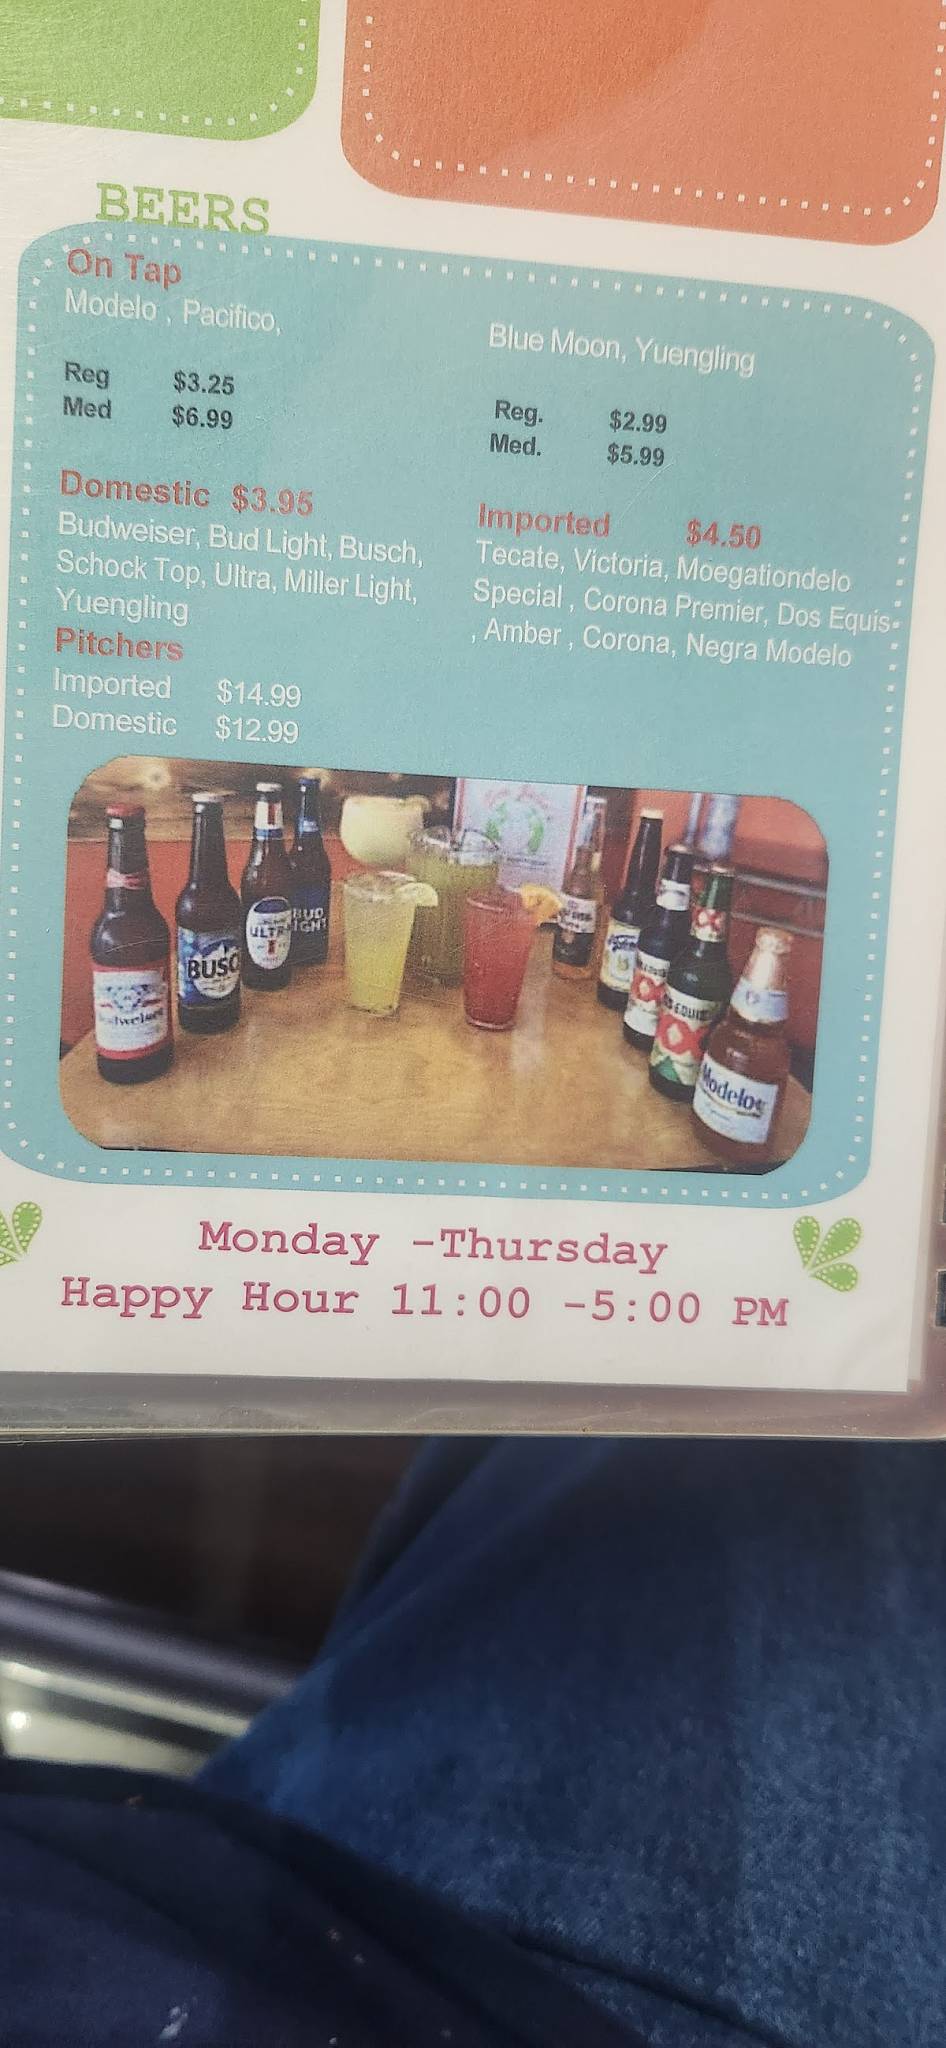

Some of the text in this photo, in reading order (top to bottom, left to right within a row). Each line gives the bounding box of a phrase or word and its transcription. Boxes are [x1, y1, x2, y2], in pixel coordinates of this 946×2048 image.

[96, 182, 271, 236] BEERS
[67, 248, 183, 291] On Tap
[64, 287, 157, 321] Modelo
[183, 299, 282, 336] Pacifico,
[489, 323, 756, 379] Blue Moon, Yuengling
[64, 361, 235, 397] Reg $3.25
[62, 396, 234, 431] Med $6.99
[494, 399, 668, 435] Reg. $2.99
[489, 433, 665, 468] Med. $5.99
[60, 468, 314, 518] Domestic $3.95
[58, 511, 424, 569] Budweiser, Bud Light, Busch,
[478, 502, 762, 551] Imported $4.50
[56, 549, 418, 606] Schock Top, Ultra, Miller Light,
[475, 539, 852, 594] Tecate, Victoria, Moegationdelo
[56, 587, 189, 627] Yuengling
[473, 577, 562, 610] Special
[583, 587, 667, 618] Corona
[675, 594, 769, 629] Premier,
[778, 603, 821, 628] Dos
[55, 626, 184, 662] Pitchers
[484, 617, 562, 646] Amber
[582, 625, 677, 659] Corona,
[686, 632, 758, 666] Negra
[766, 638, 852, 669] Modelo
[53, 667, 301, 708] Imported $14.99
[52, 704, 299, 744] Domestic $12.99
[198, 1220, 668, 1276] Monday -Thursday
[61, 1275, 789, 1327] Happy Hour 11:00 -5:00 PM
